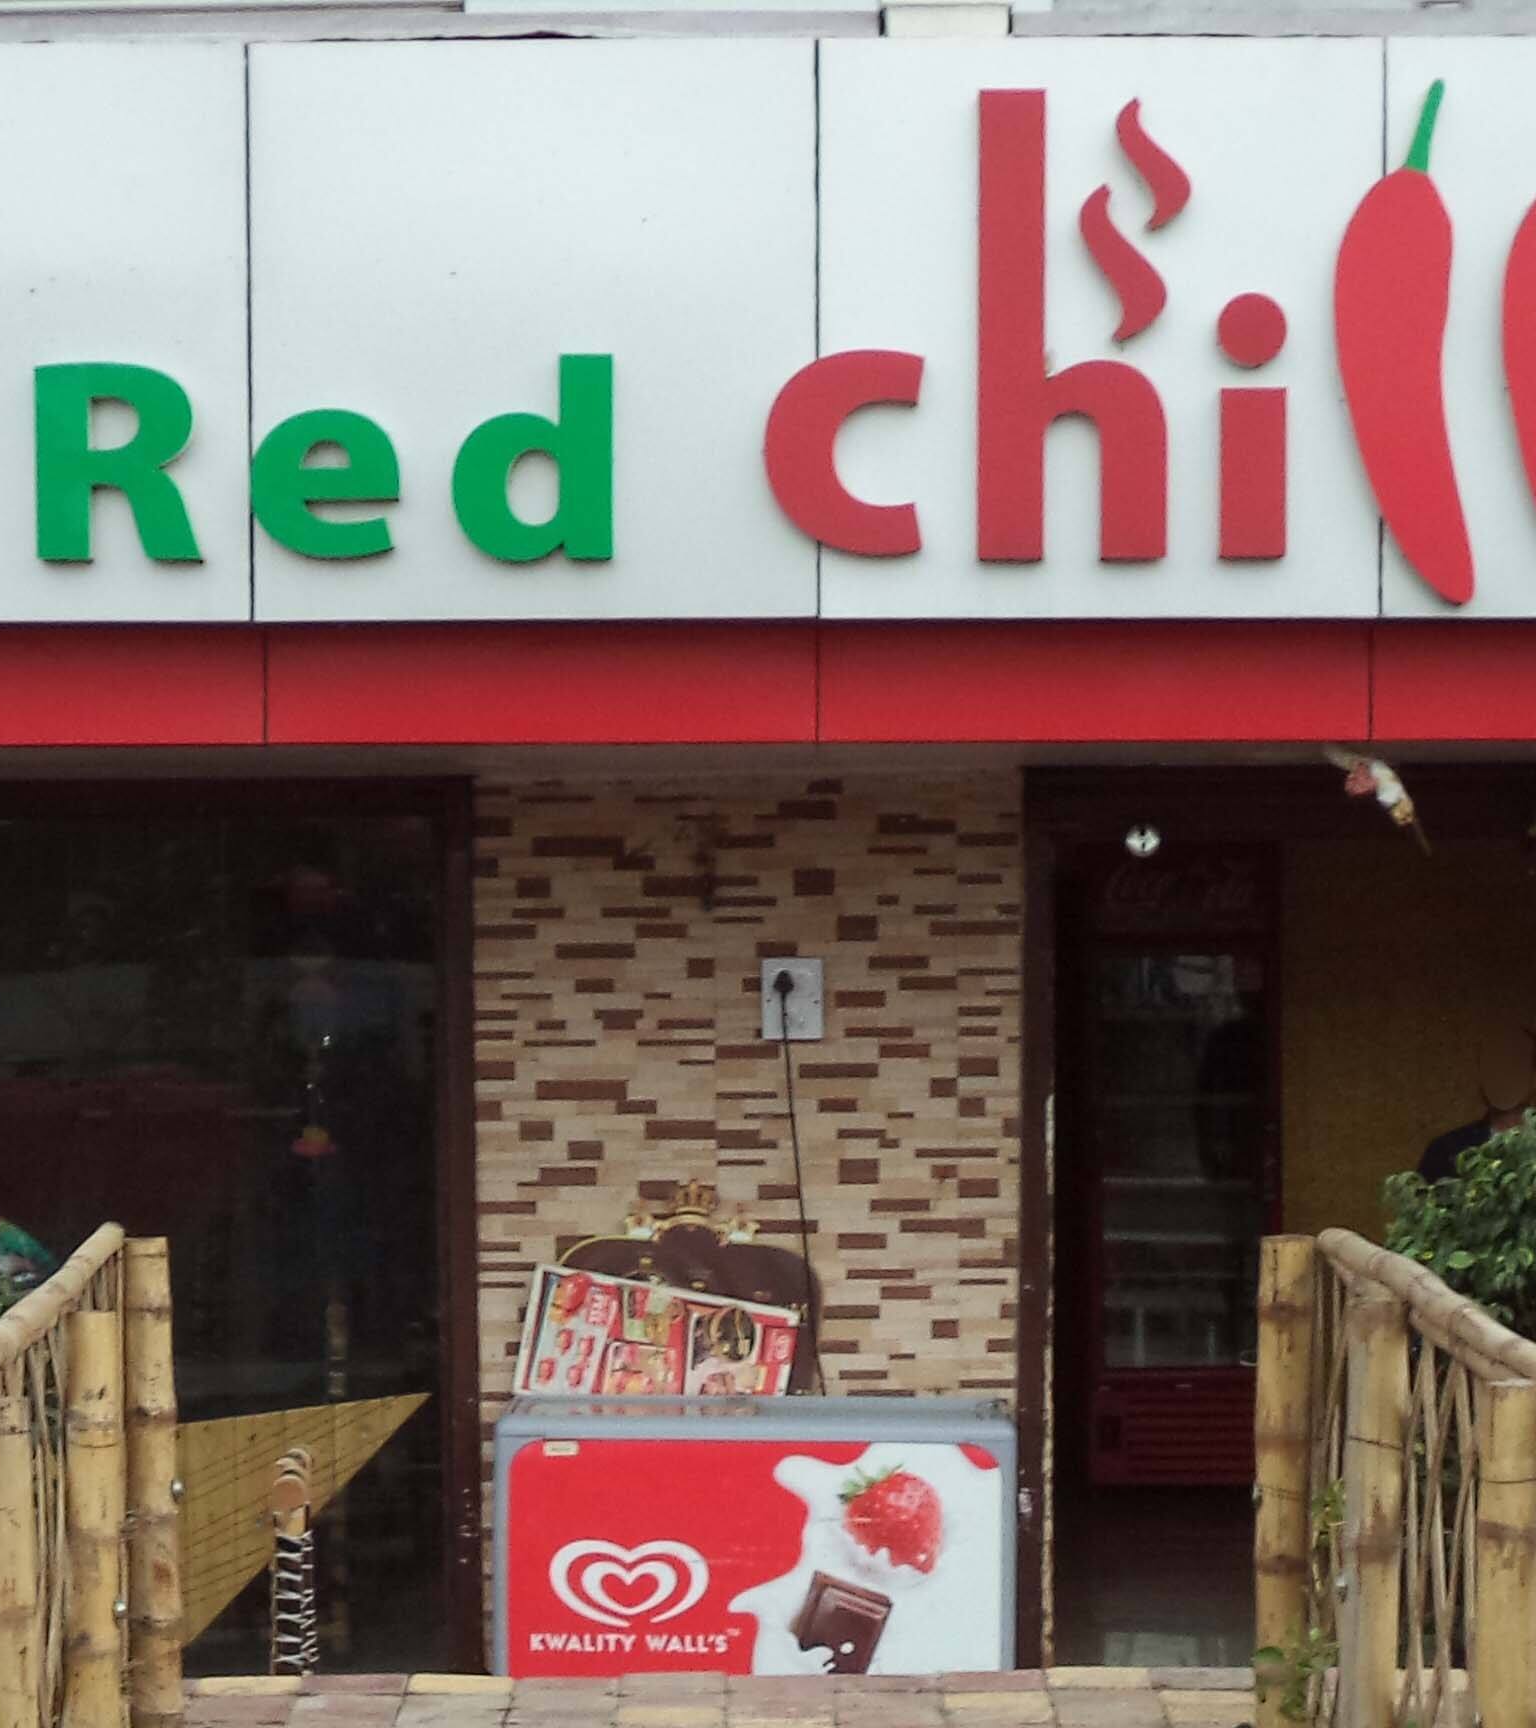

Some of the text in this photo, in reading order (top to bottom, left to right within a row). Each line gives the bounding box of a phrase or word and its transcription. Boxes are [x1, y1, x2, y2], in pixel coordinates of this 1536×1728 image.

[34, 353, 614, 564] Red
[529, 1633, 729, 1653] KWALITY WALL'S
